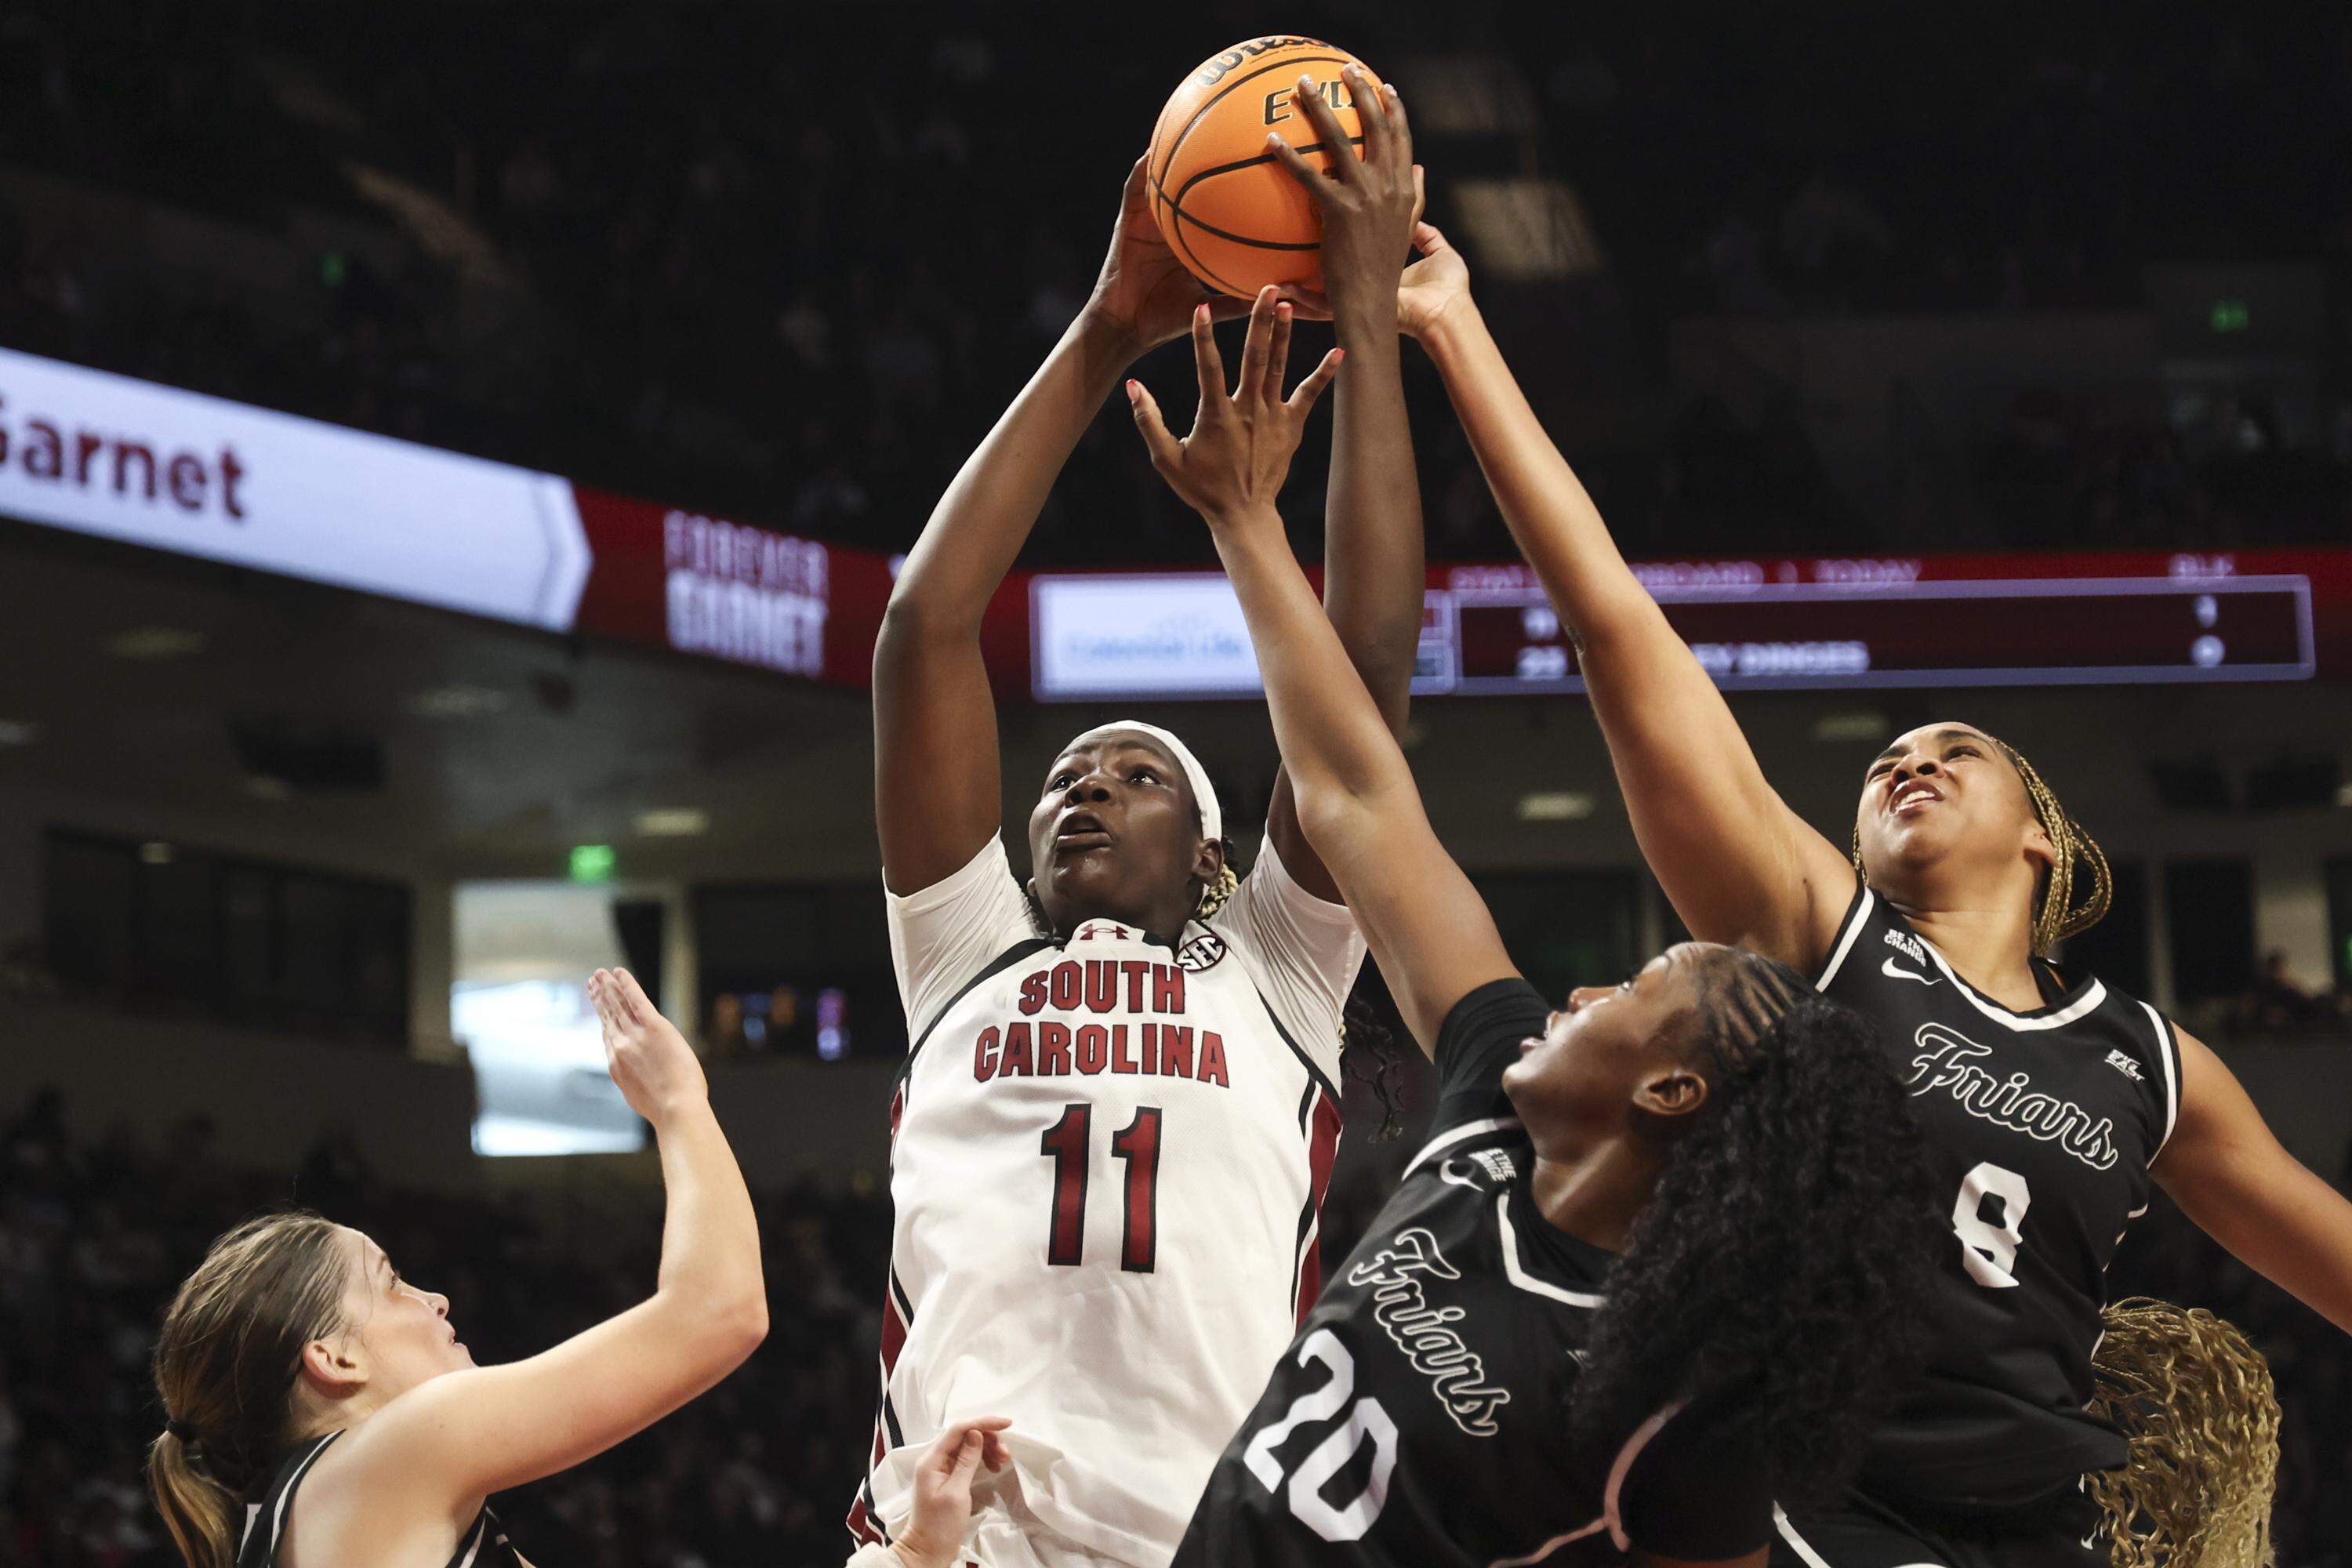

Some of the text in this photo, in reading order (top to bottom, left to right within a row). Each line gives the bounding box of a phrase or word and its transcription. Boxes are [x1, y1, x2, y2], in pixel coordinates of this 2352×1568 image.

[1018, 960, 1185, 1016] SOUTH
[1177, 936, 1224, 971] SEC
[1888, 928, 1906, 942] BE
[974, 1021, 1229, 1088] CAROLINA
[1907, 1022, 2118, 1171] Friars
[1040, 1103, 1162, 1274] 11
[1348, 1227, 1511, 1437] Friars
[1243, 1328, 1399, 1543] 20
